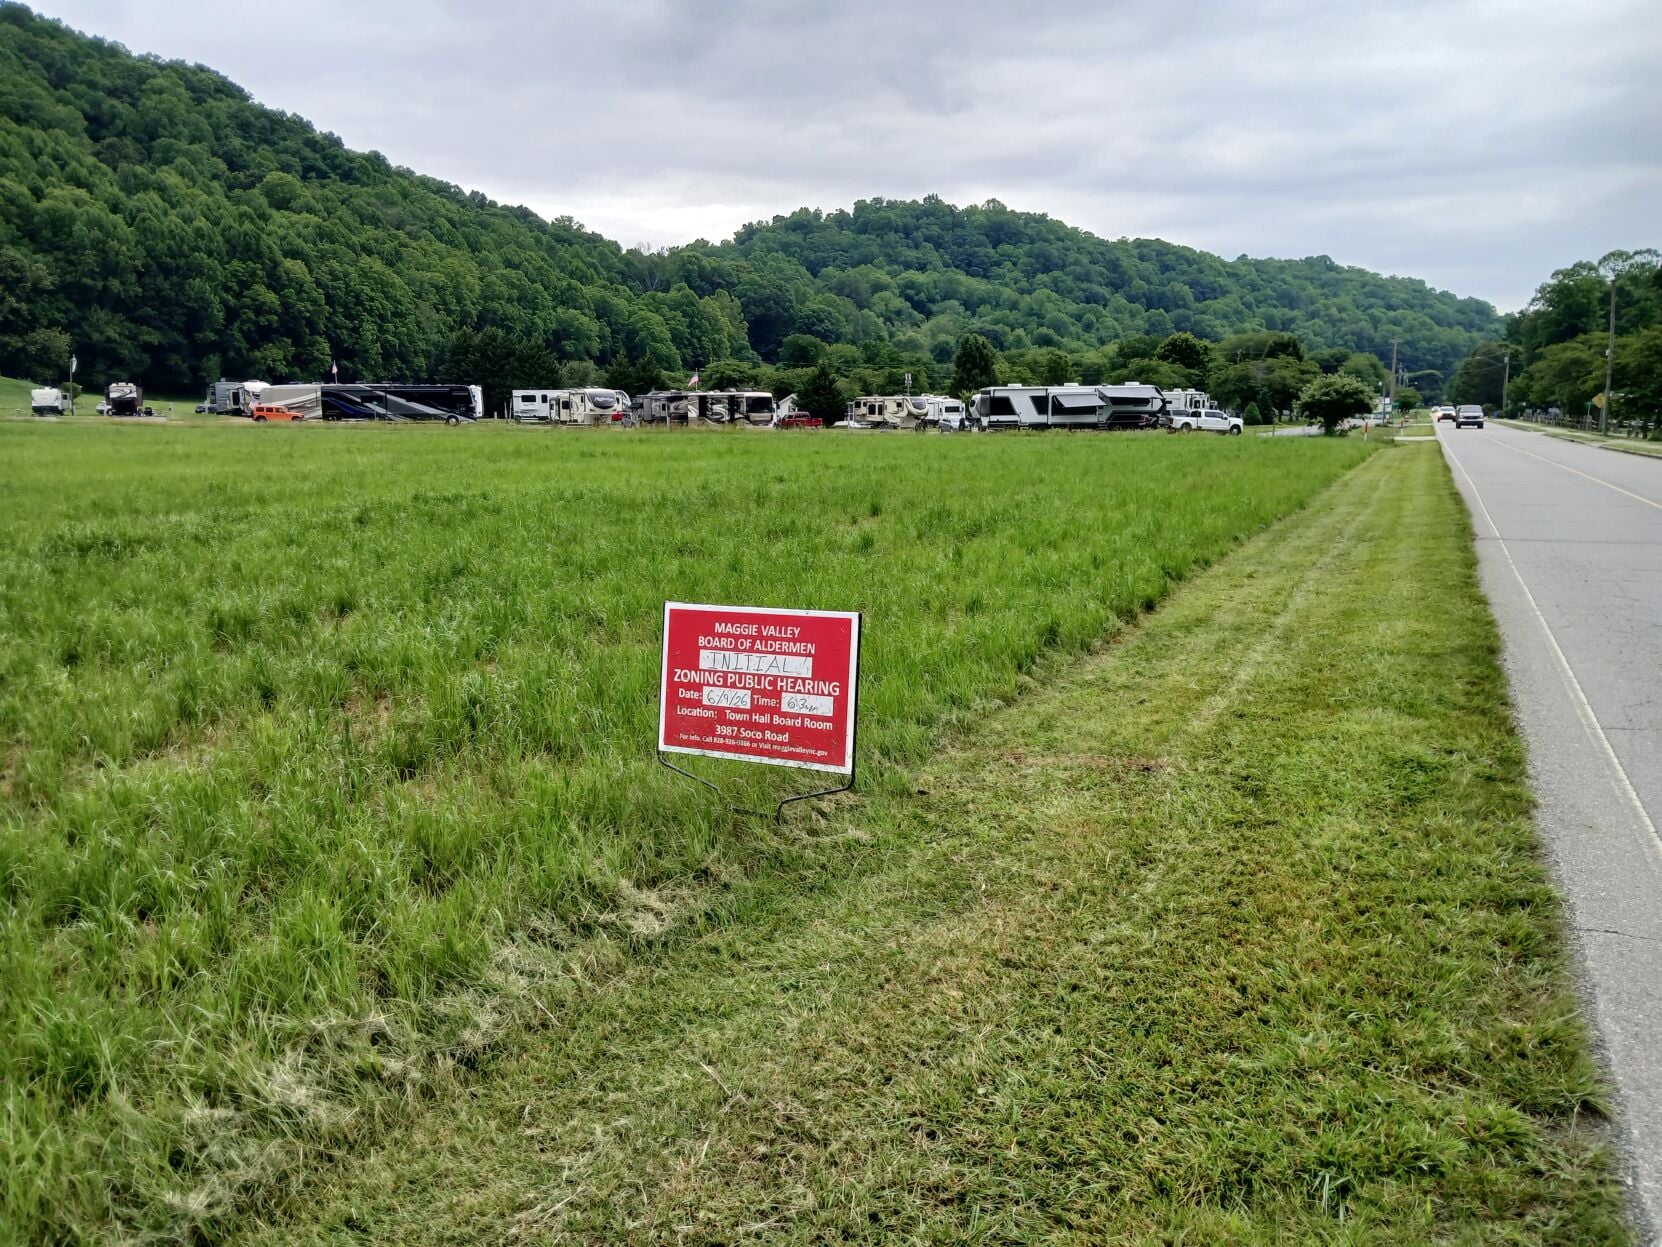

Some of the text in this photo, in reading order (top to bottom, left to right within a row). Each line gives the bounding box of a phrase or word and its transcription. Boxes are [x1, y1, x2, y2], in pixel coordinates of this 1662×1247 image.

[714, 622, 800, 638] MAGGIE VALLEY
[698, 635, 816, 654] BOARD OF ALDERMEN
[708, 652, 801, 675] INITIAL
[673, 669, 840, 696] ZONING PUBLIC HEARING
[678, 688, 702, 700] Date:
[707, 689, 748, 706] 6/9/26
[753, 694, 780, 707] Time:
[677, 705, 833, 731] Location: Town Hall Board Room
[715, 724, 789, 743] 3987 Soco Road
[759, 742, 771, 750] Visit
